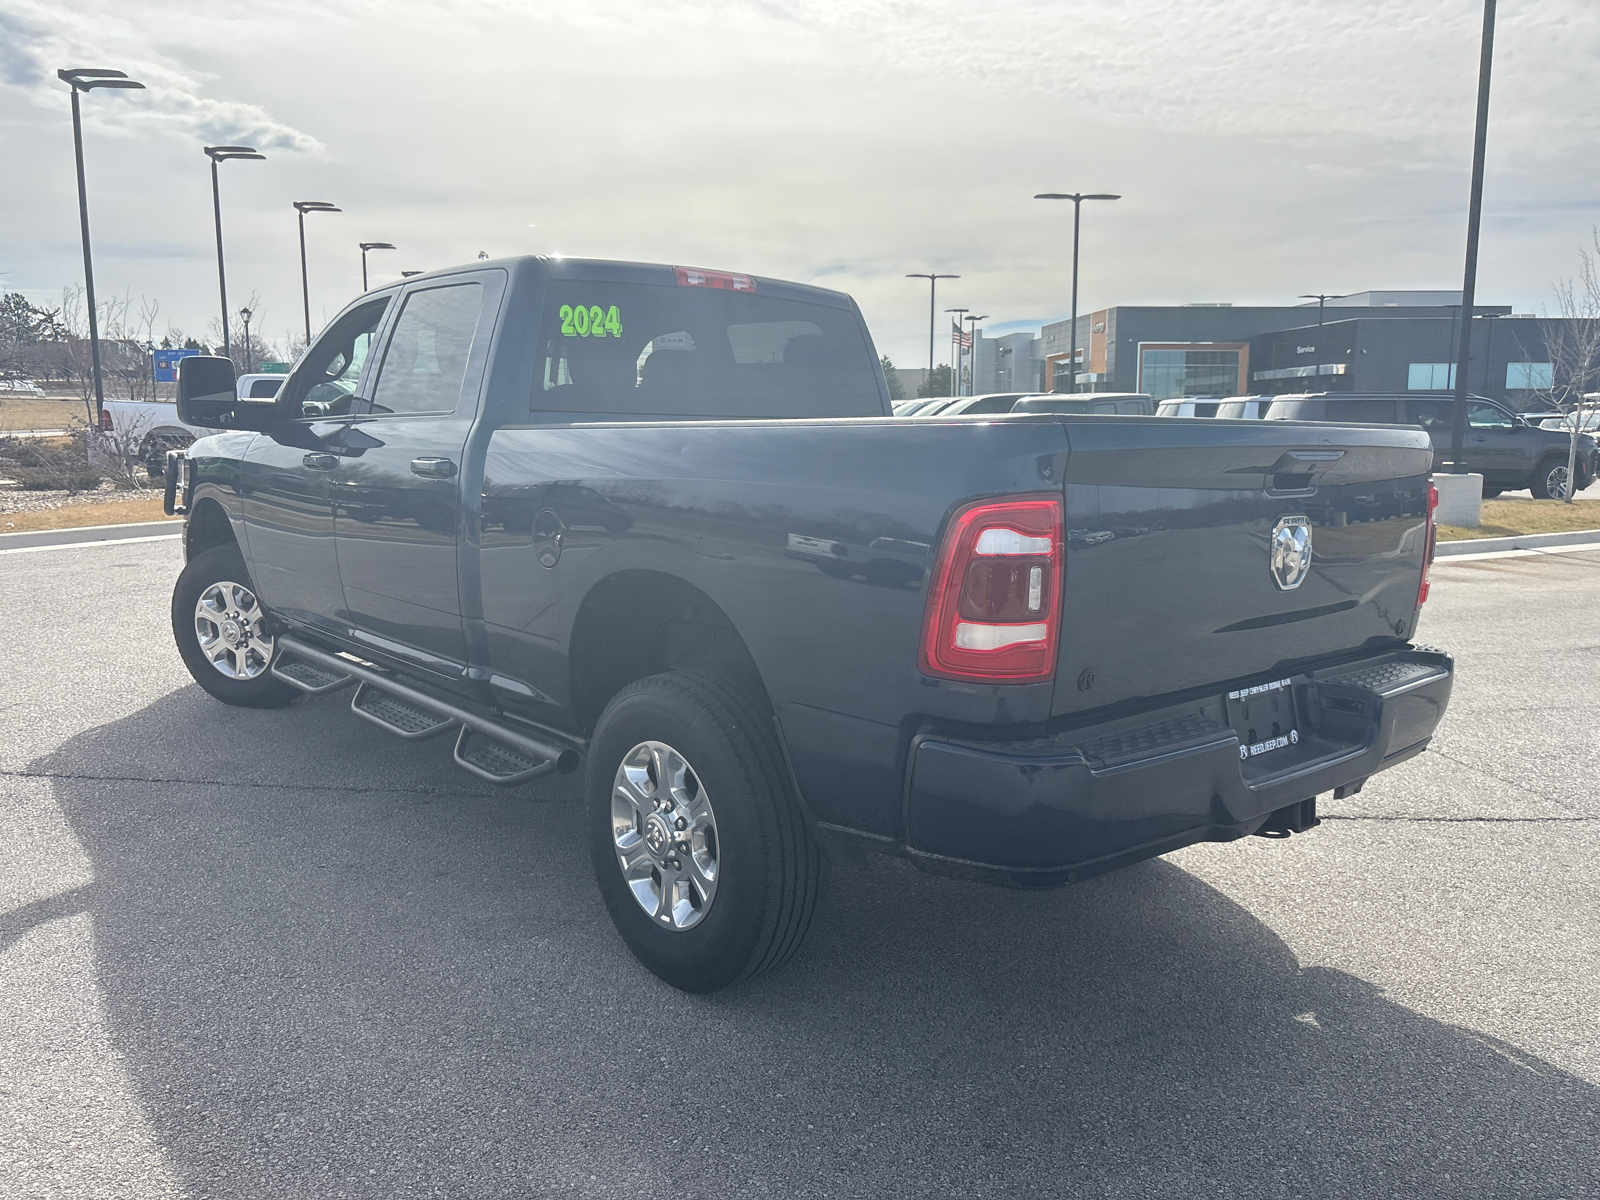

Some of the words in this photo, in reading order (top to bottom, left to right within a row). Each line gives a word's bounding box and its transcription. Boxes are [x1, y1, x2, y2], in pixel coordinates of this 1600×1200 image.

[559, 304, 623, 338] 2024
[1228, 690, 1240, 700] REED
[1240, 688, 1249, 698] JEEP
[1249, 683, 1269, 695] CHRYSLER
[1269, 680, 1281, 690] DODGE
[1281, 678, 1291, 687] RAM
[1249, 736, 1289, 756] REEDJEEP.COM
